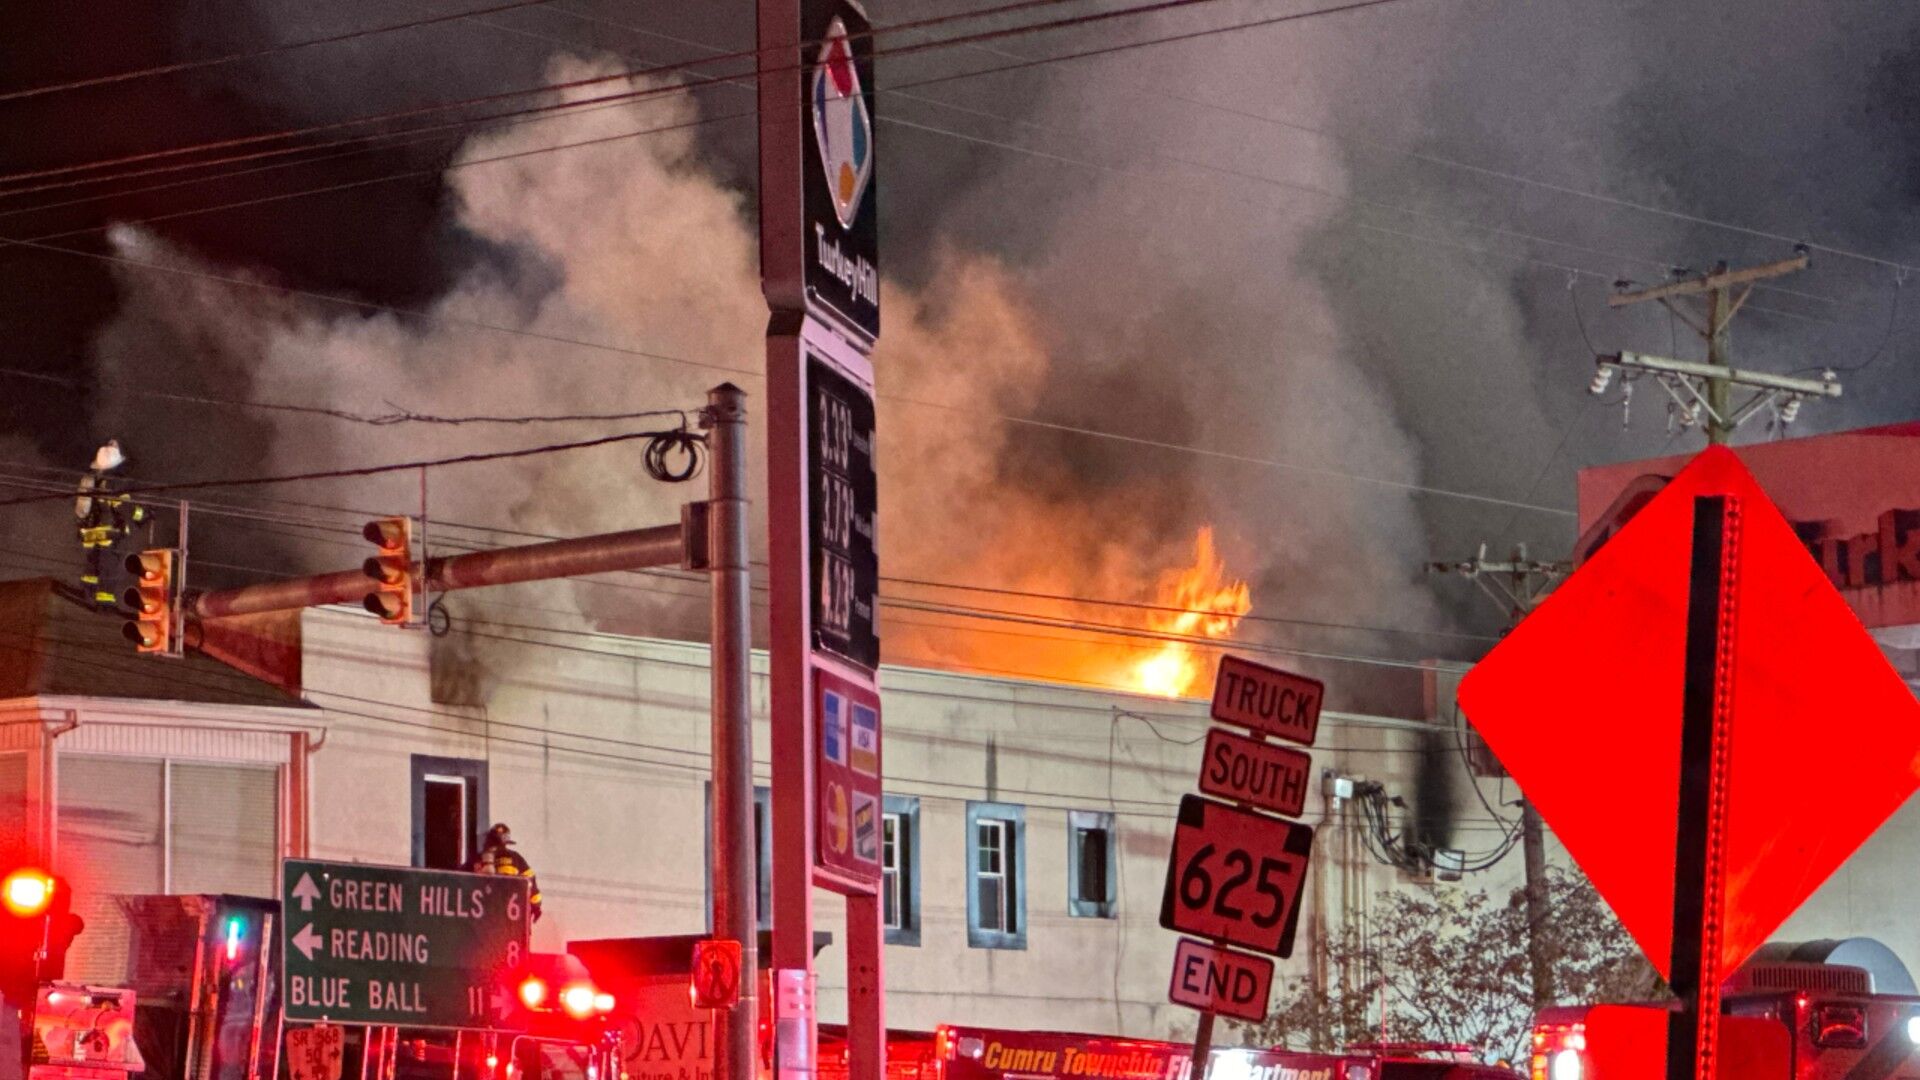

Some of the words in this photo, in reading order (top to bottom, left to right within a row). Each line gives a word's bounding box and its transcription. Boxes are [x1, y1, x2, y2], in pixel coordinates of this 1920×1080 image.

[1226, 671, 1313, 731] TRUCK
[1210, 742, 1302, 803] SOUTH
[329, 878, 403, 912] GREEN
[420, 885, 484, 919] HILLS
[506, 892, 521, 921] 6
[1180, 842, 1292, 929] 625
[330, 927, 429, 964] READING
[506, 941, 520, 968] 8
[291, 975, 351, 1008] BLUE
[368, 979, 427, 1012] BALL
[468, 986, 483, 1016] 11
[1181, 955, 1258, 1005] END
[985, 1041, 1057, 1072] Cumru
[1062, 1046, 1163, 1080] Township
